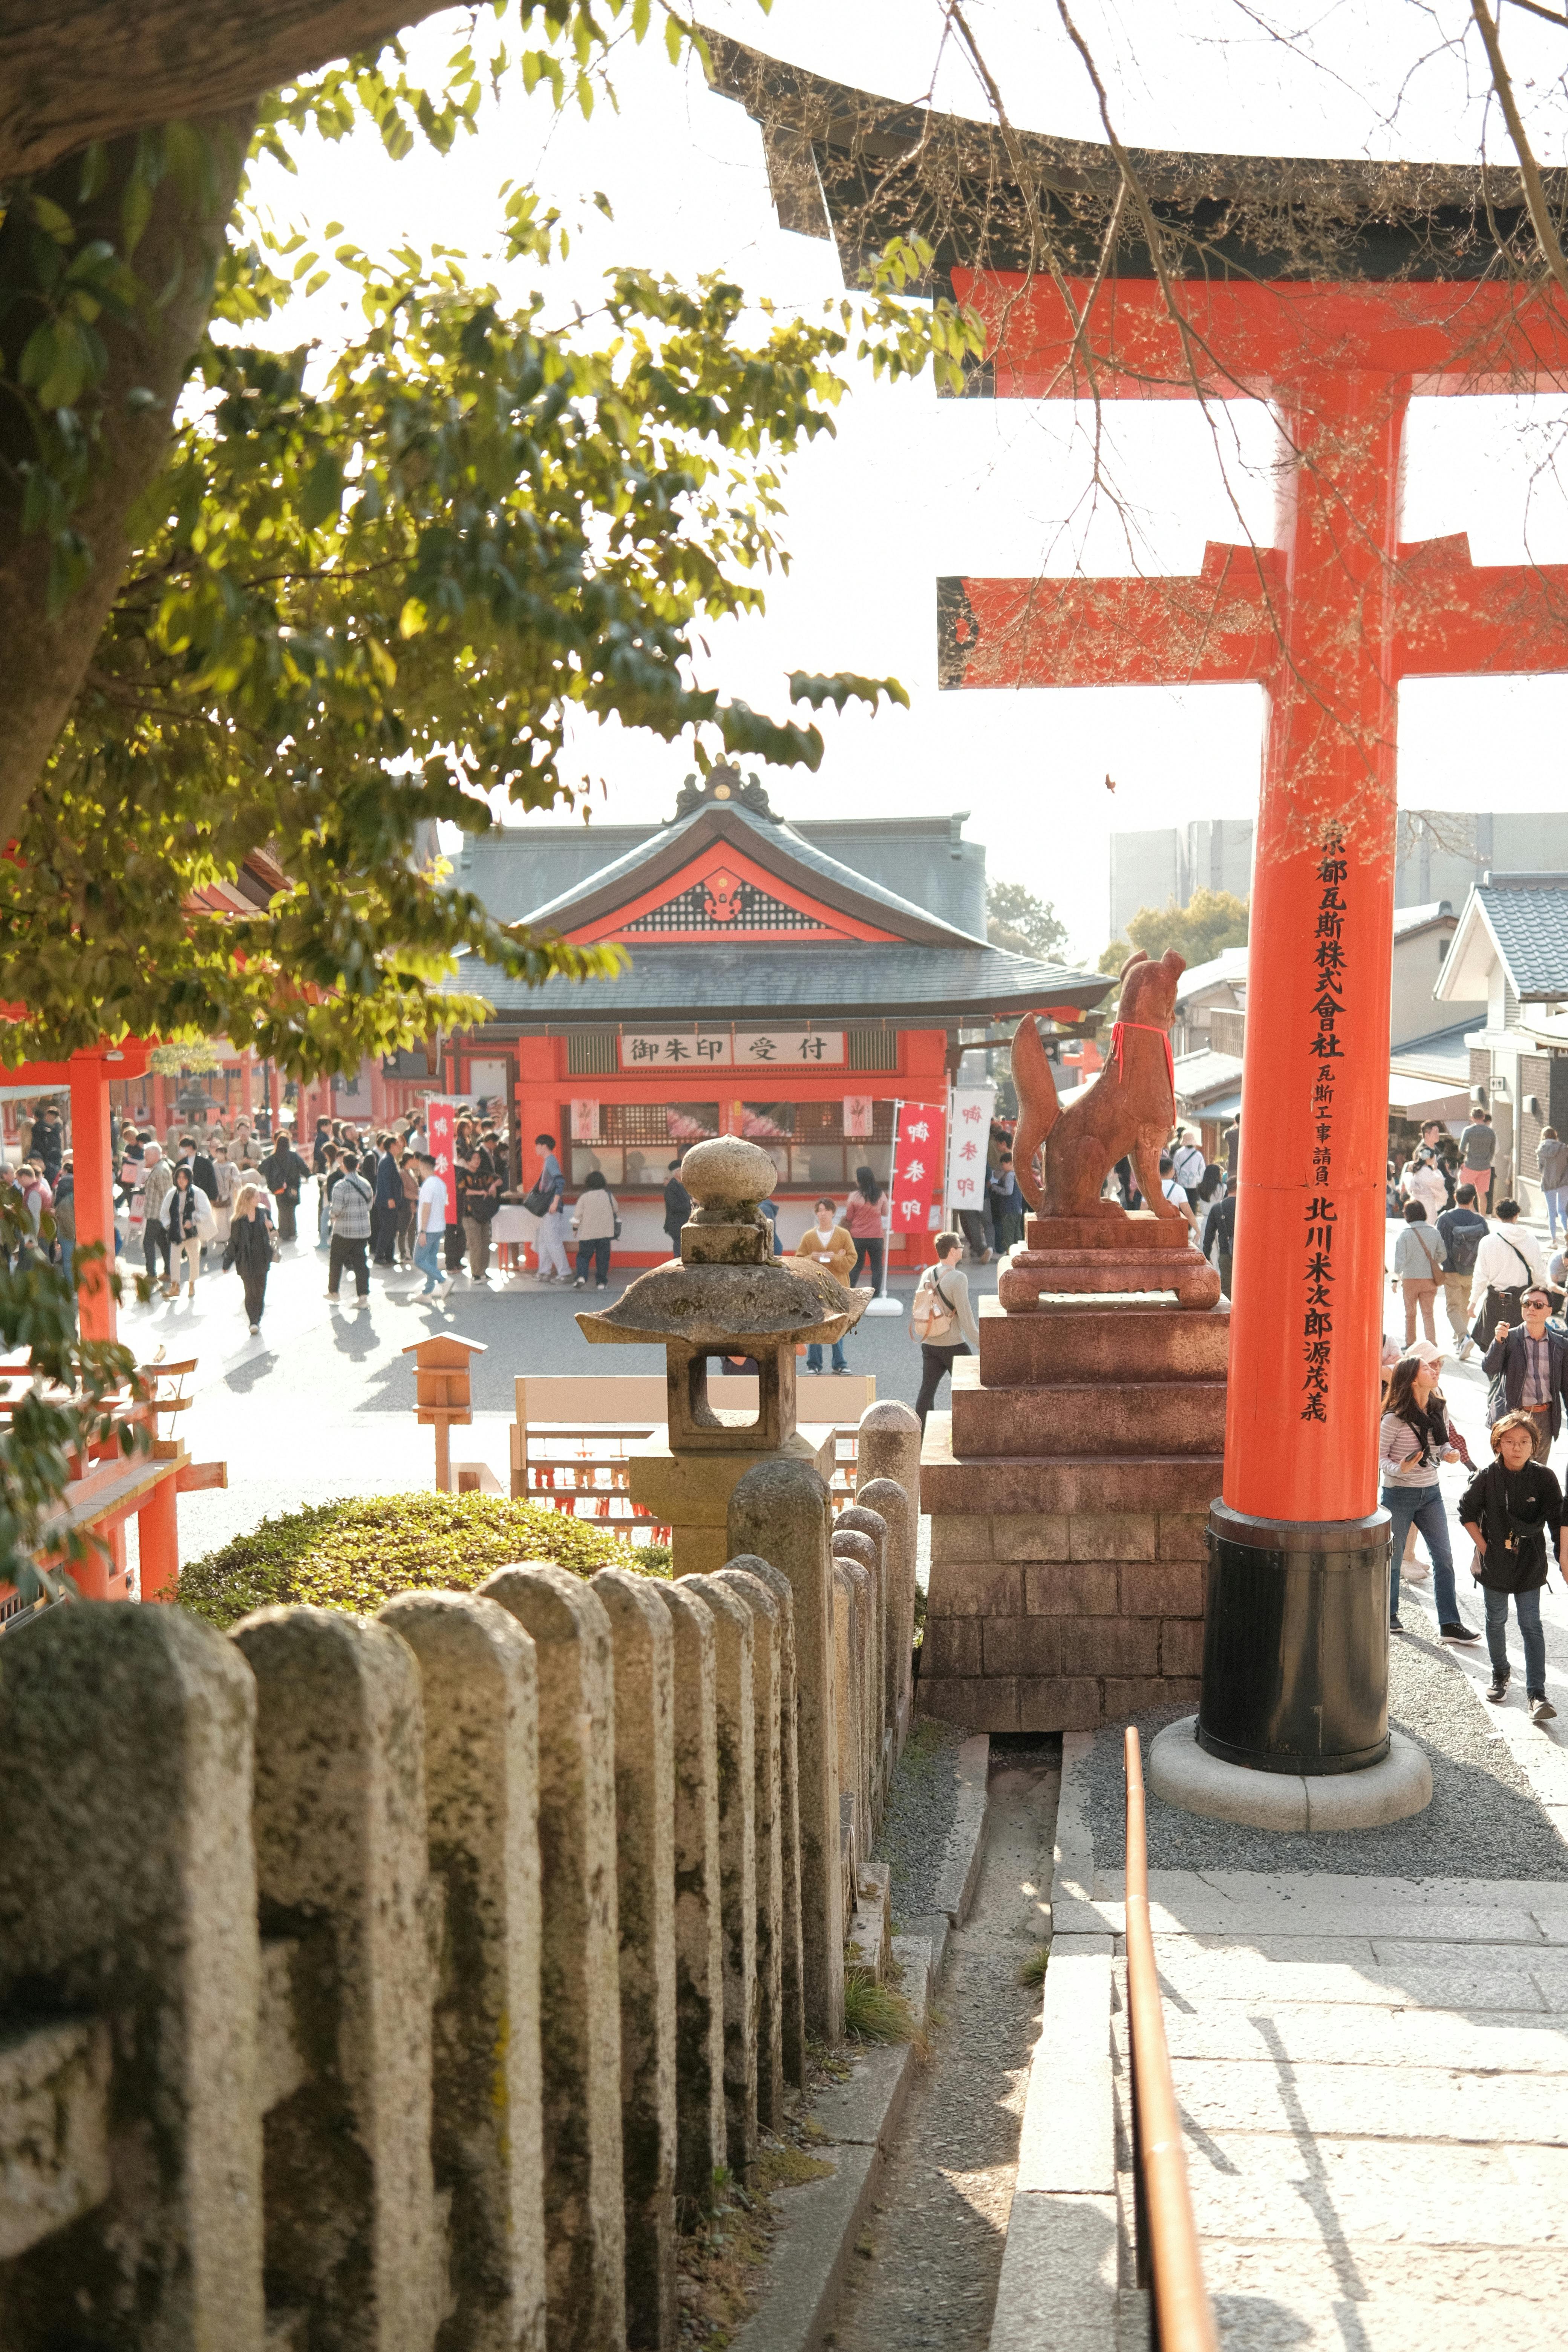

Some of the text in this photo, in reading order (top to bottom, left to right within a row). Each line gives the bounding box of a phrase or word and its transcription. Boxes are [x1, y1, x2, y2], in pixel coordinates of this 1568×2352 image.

[631, 1037, 827, 1062] 御朱印 受付
[1301, 819, 1348, 1423] 京都瓦斯株式會社 瓦斯工事請負 北川米次郎源茂義
